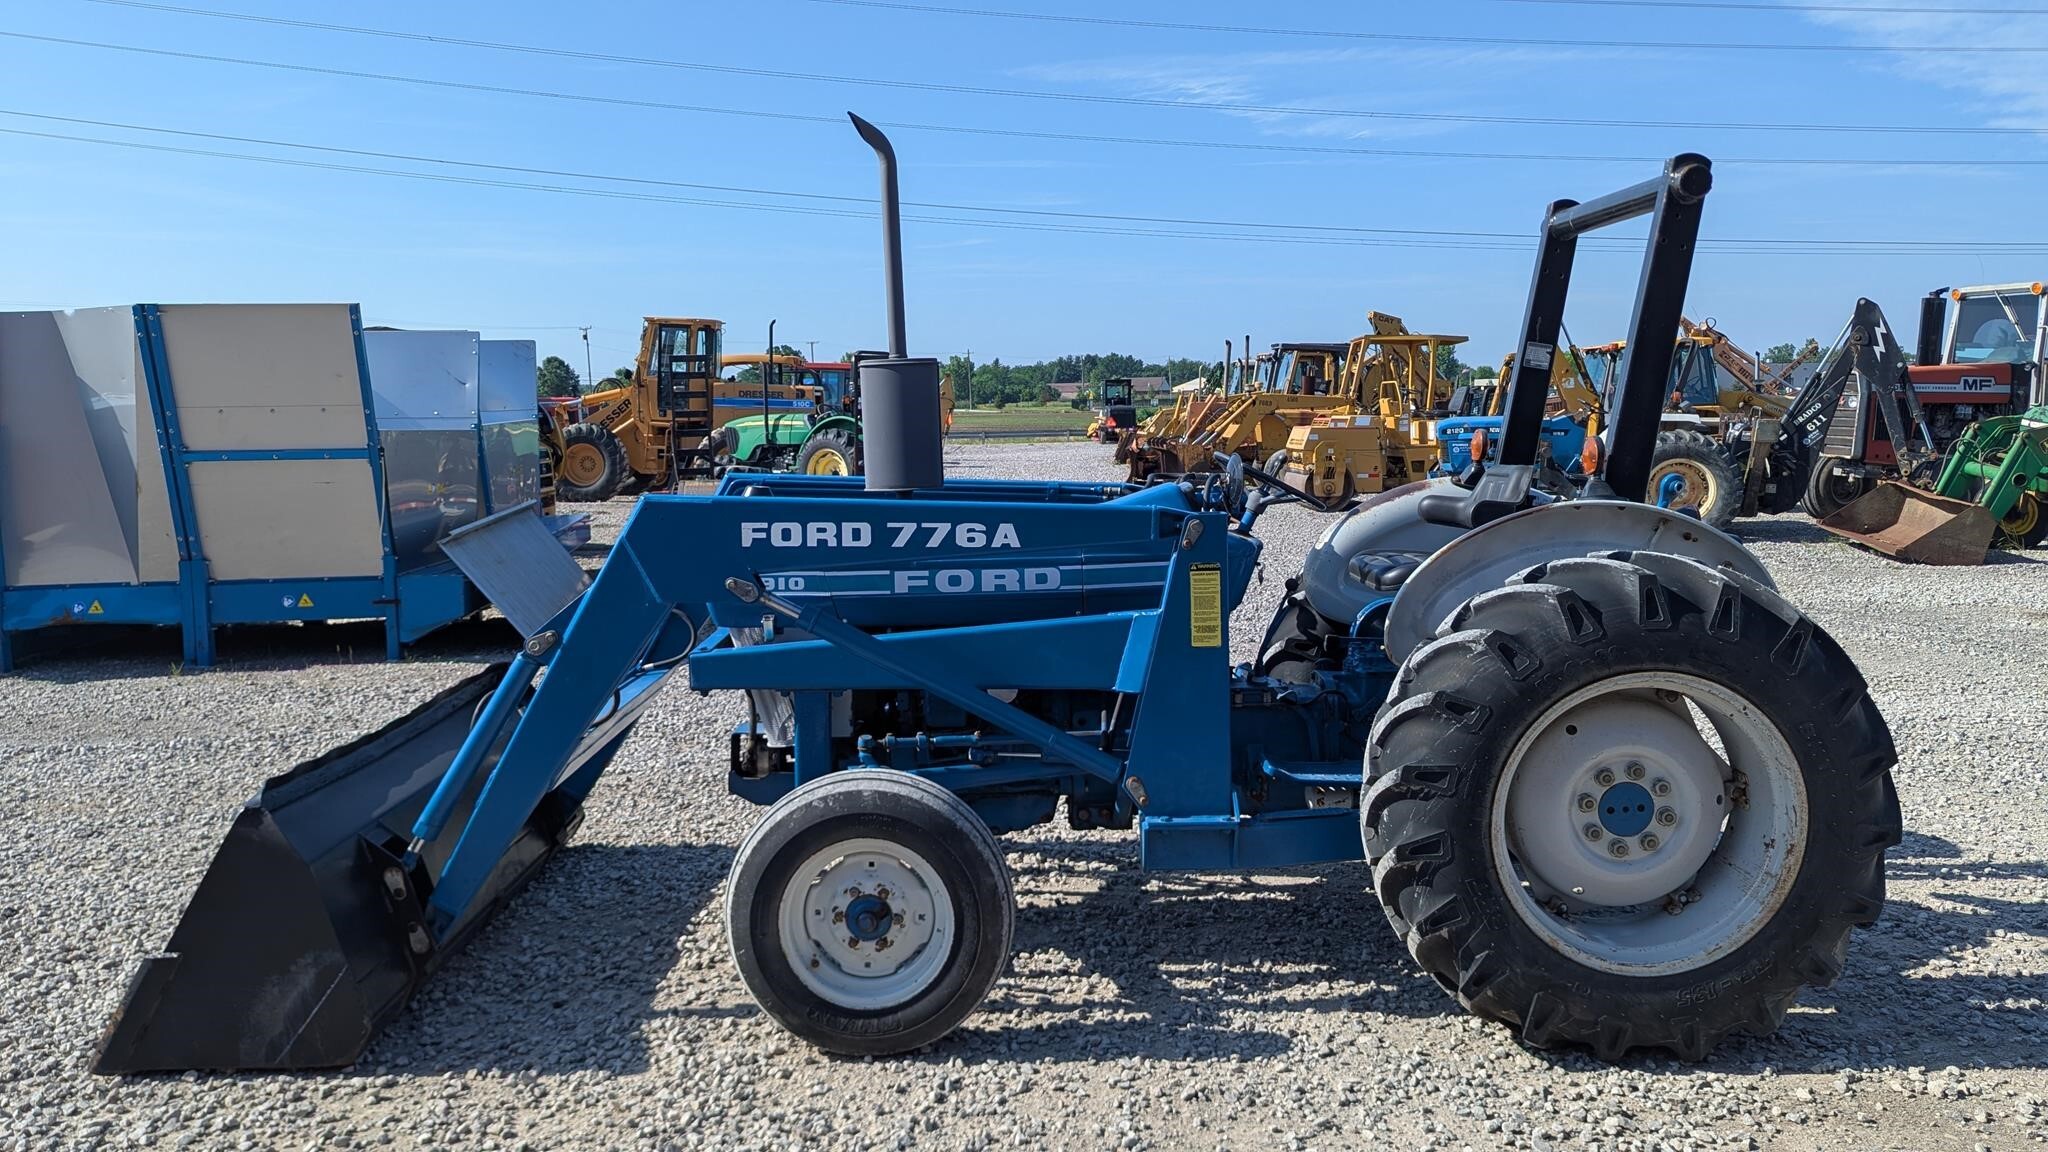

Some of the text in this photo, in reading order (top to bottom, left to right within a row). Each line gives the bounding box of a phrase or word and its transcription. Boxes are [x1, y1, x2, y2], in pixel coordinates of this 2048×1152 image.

[1379, 315, 1395, 324] CAT
[1963, 379, 1993, 391] MF
[1806, 414, 1828, 431] 611
[1446, 427, 1464, 435] 2120
[741, 522, 1021, 548] FORD 776A
[894, 567, 1061, 594] FORD
